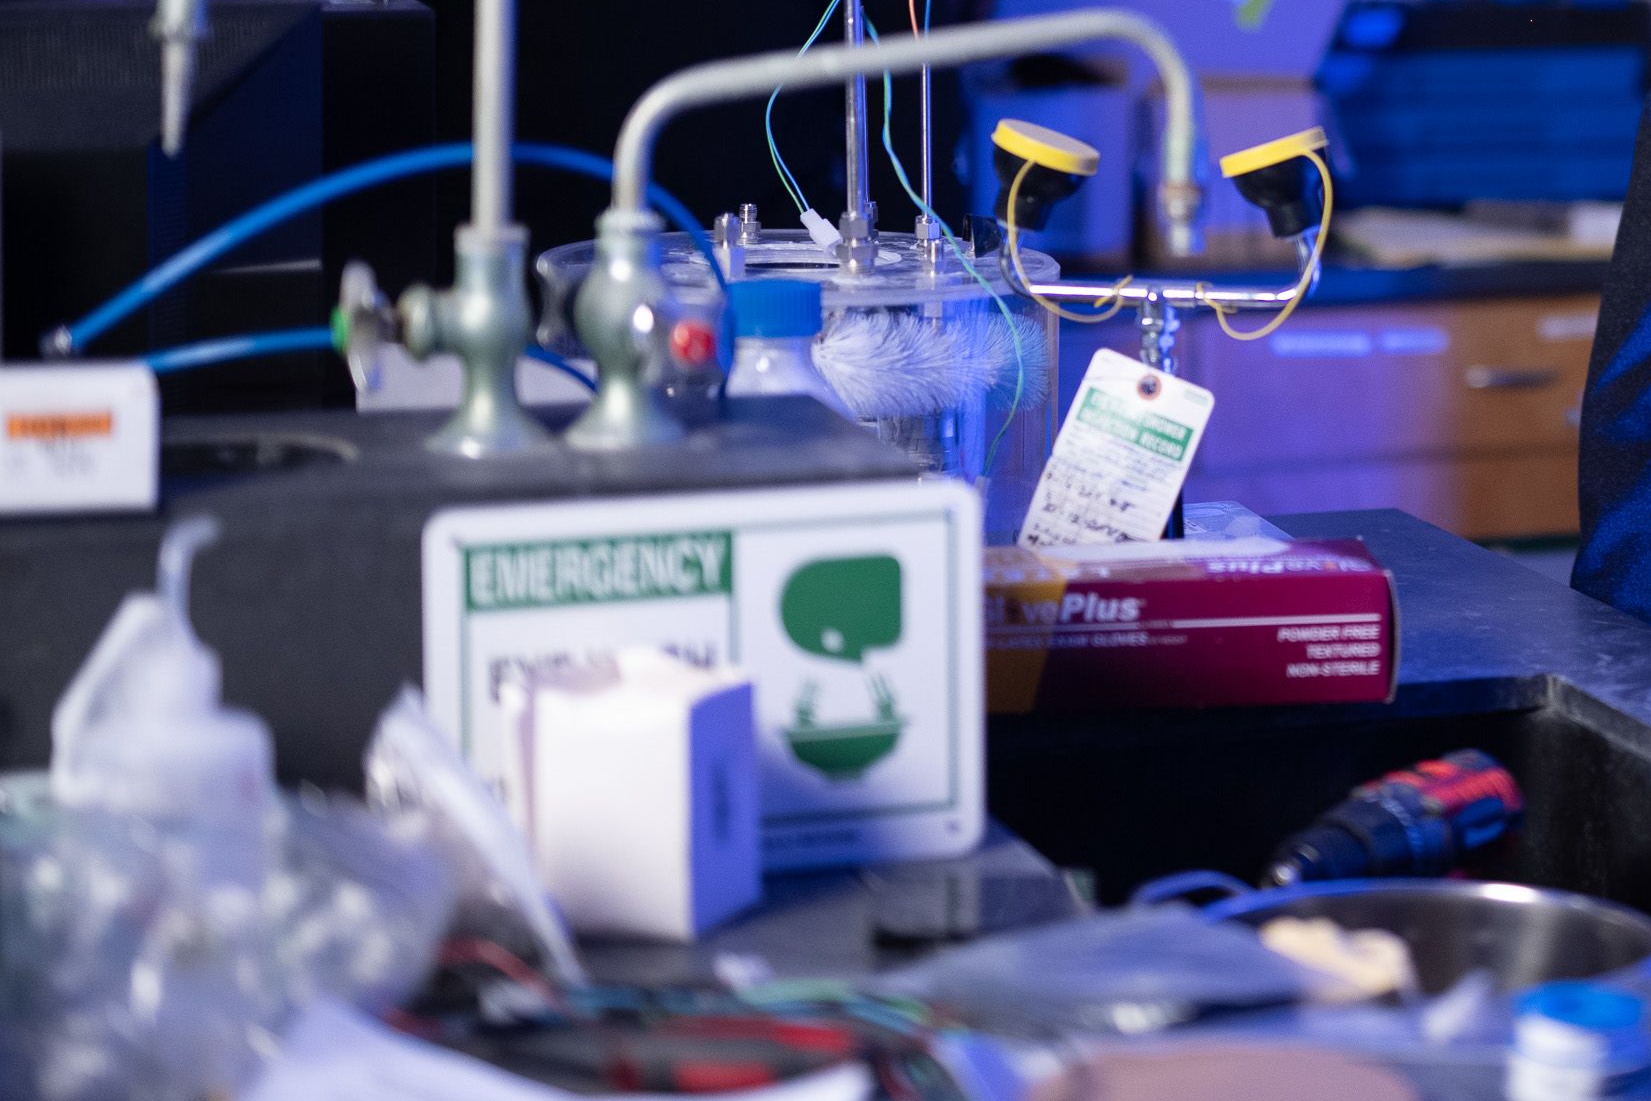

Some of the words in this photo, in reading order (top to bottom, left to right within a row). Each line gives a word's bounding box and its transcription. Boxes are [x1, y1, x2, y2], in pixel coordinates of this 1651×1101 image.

[470, 540, 724, 604] EMERGENCY
[1344, 624, 1381, 641] FREE
[1305, 642, 1381, 658] TEXTURED
[1286, 661, 1381, 677] NON-STERILE
